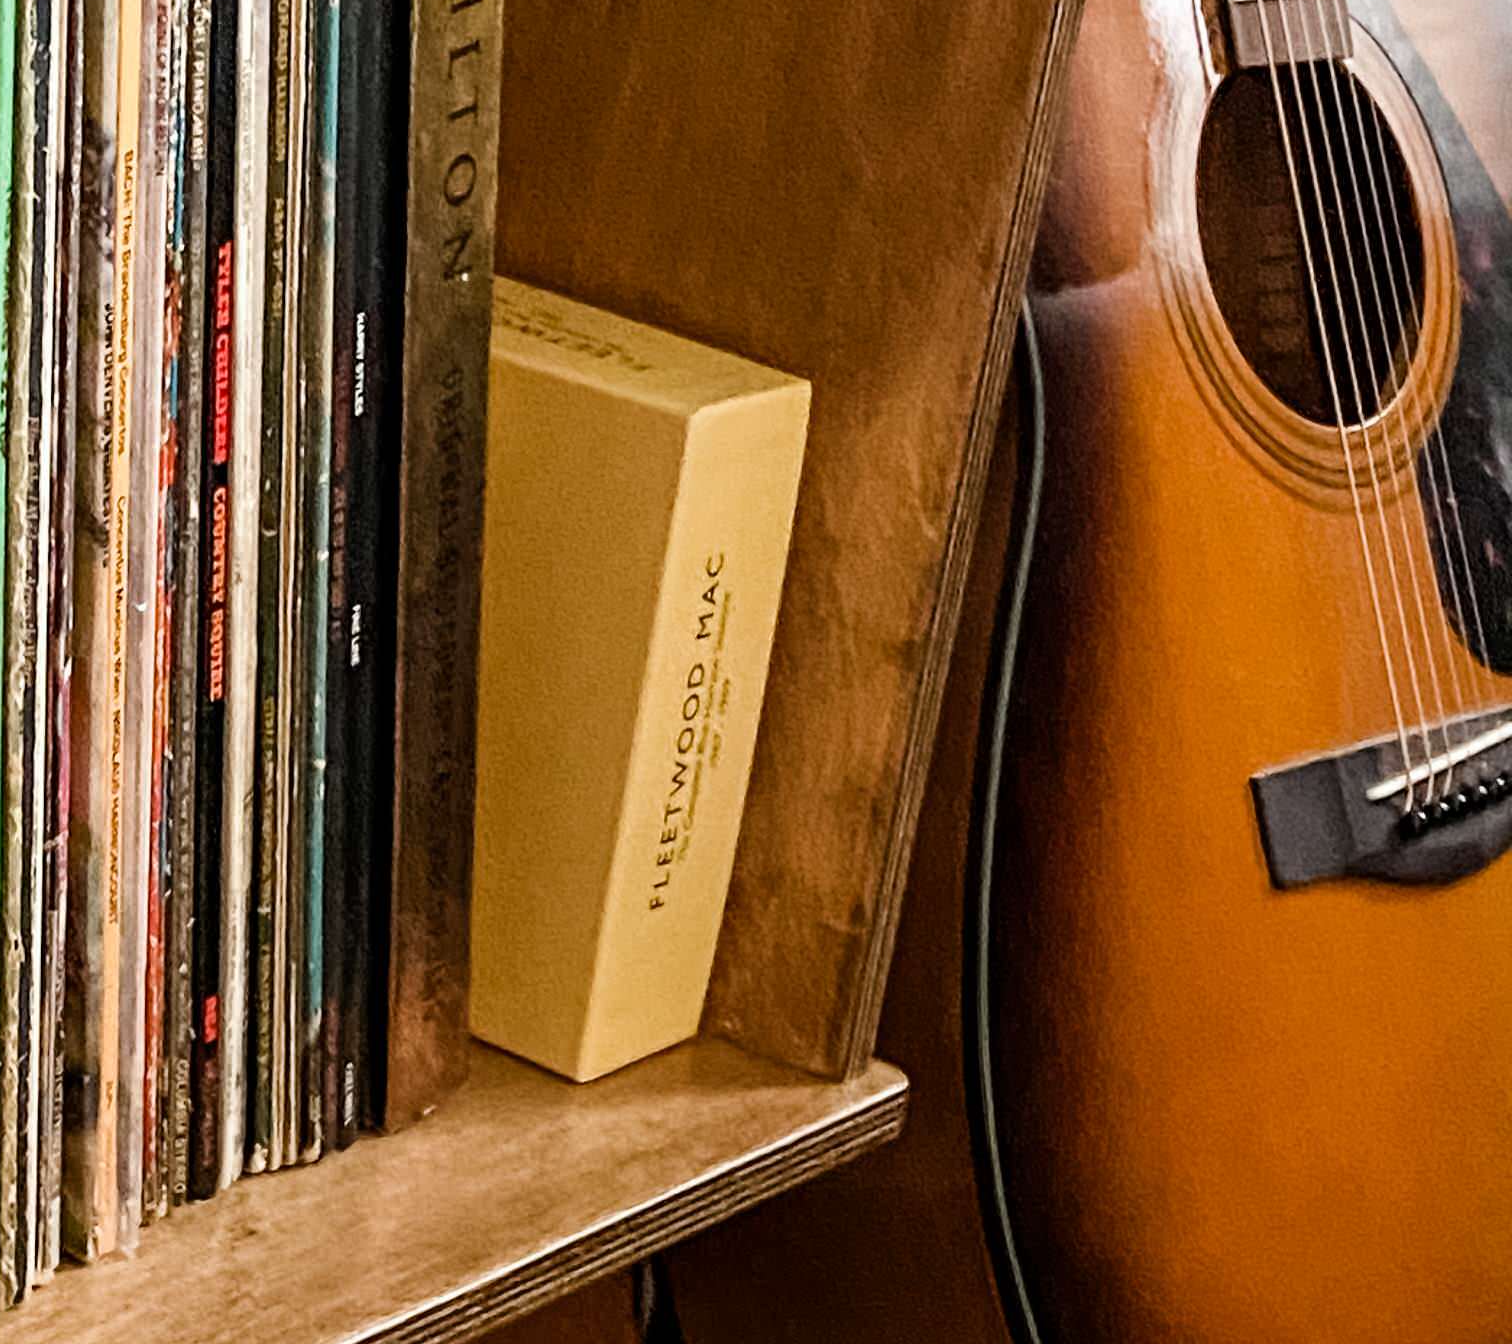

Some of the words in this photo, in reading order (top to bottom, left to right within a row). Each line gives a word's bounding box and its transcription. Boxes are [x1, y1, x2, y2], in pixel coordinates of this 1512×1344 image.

[192, 60, 206, 114] PIANO
[121, 210, 133, 244] The
[117, 249, 133, 363] Brandenburg
[217, 241, 233, 329] TYLER
[116, 366, 130, 457] Concertos
[214, 333, 232, 464] CHILDERS
[355, 362, 365, 417] STYLES
[211, 487, 227, 604] COUNTRY
[209, 607, 226, 703] SQUIRE
[649, 664, 705, 910] FLEETWOOD
[696, 553, 724, 640] MAC
